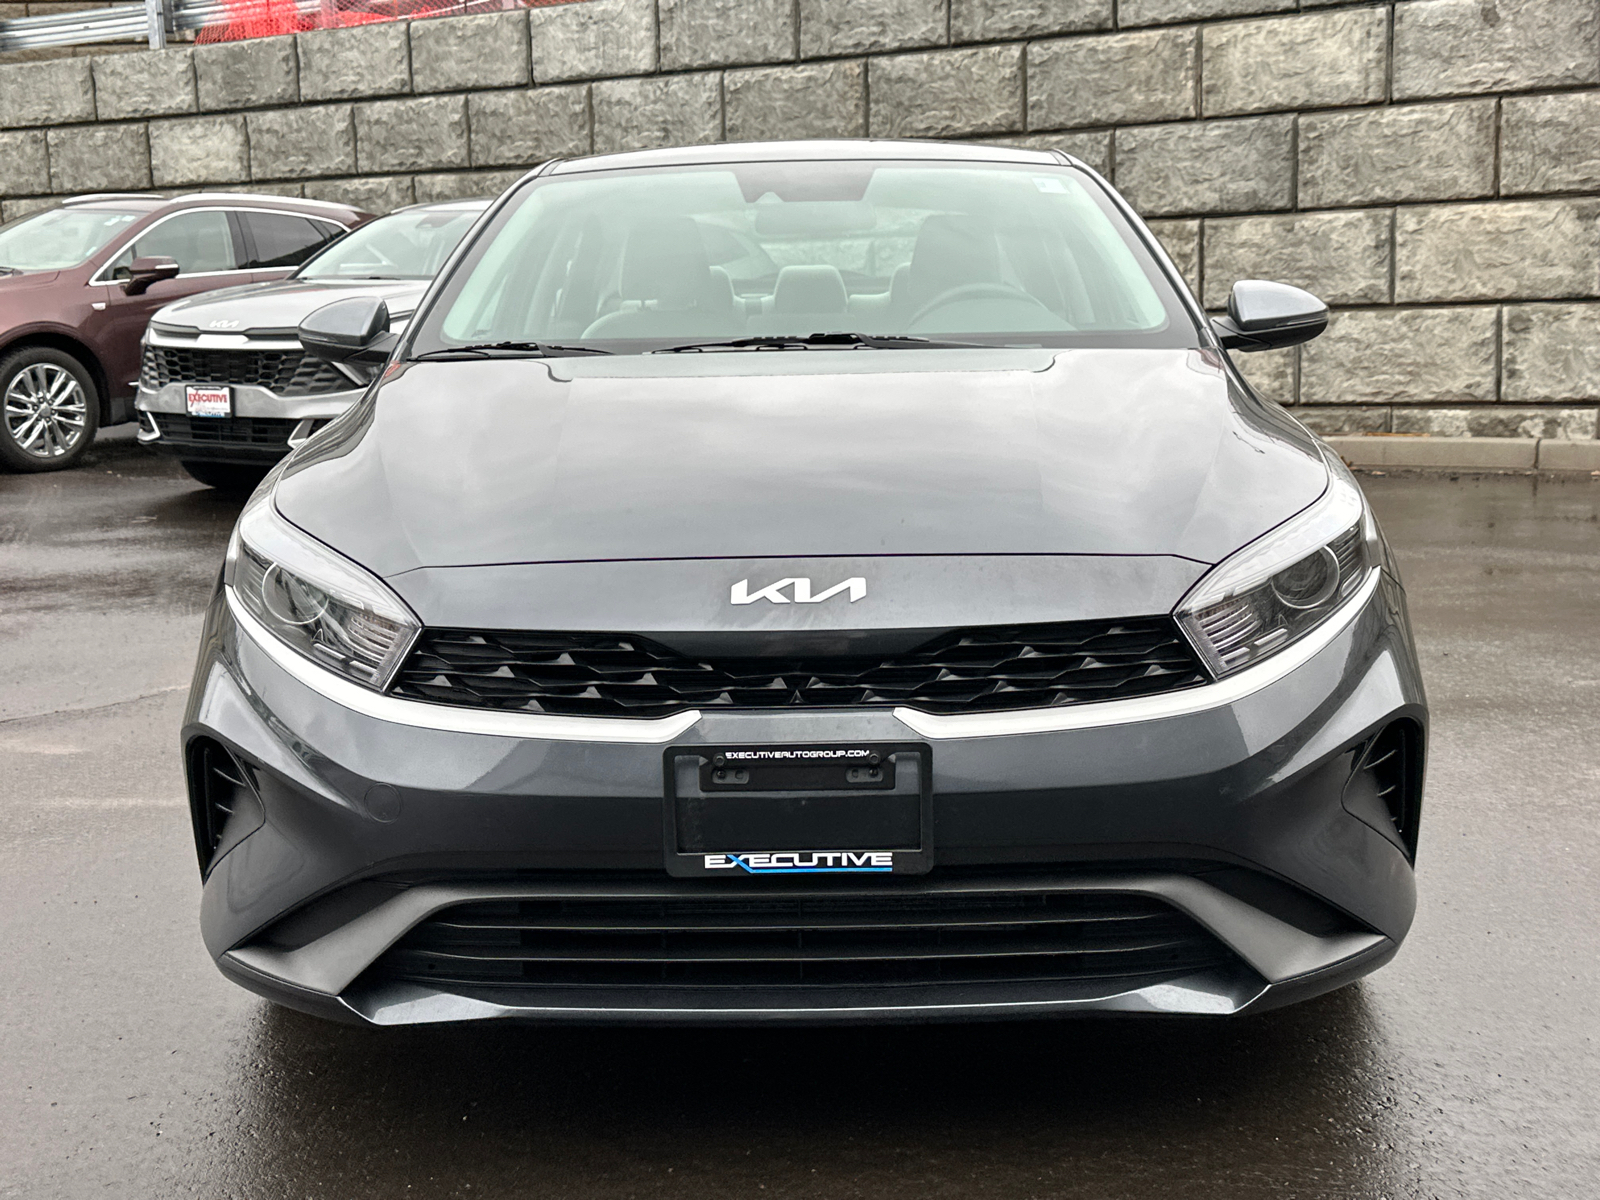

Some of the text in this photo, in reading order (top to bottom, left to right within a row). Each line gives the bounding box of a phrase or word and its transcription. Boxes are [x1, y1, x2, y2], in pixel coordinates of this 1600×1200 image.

[188, 391, 228, 406] EXECUTIVE
[725, 750, 870, 760] EXECUTIVEAUTOGROUP.COM
[704, 852, 893, 872] EXECUTIVE
